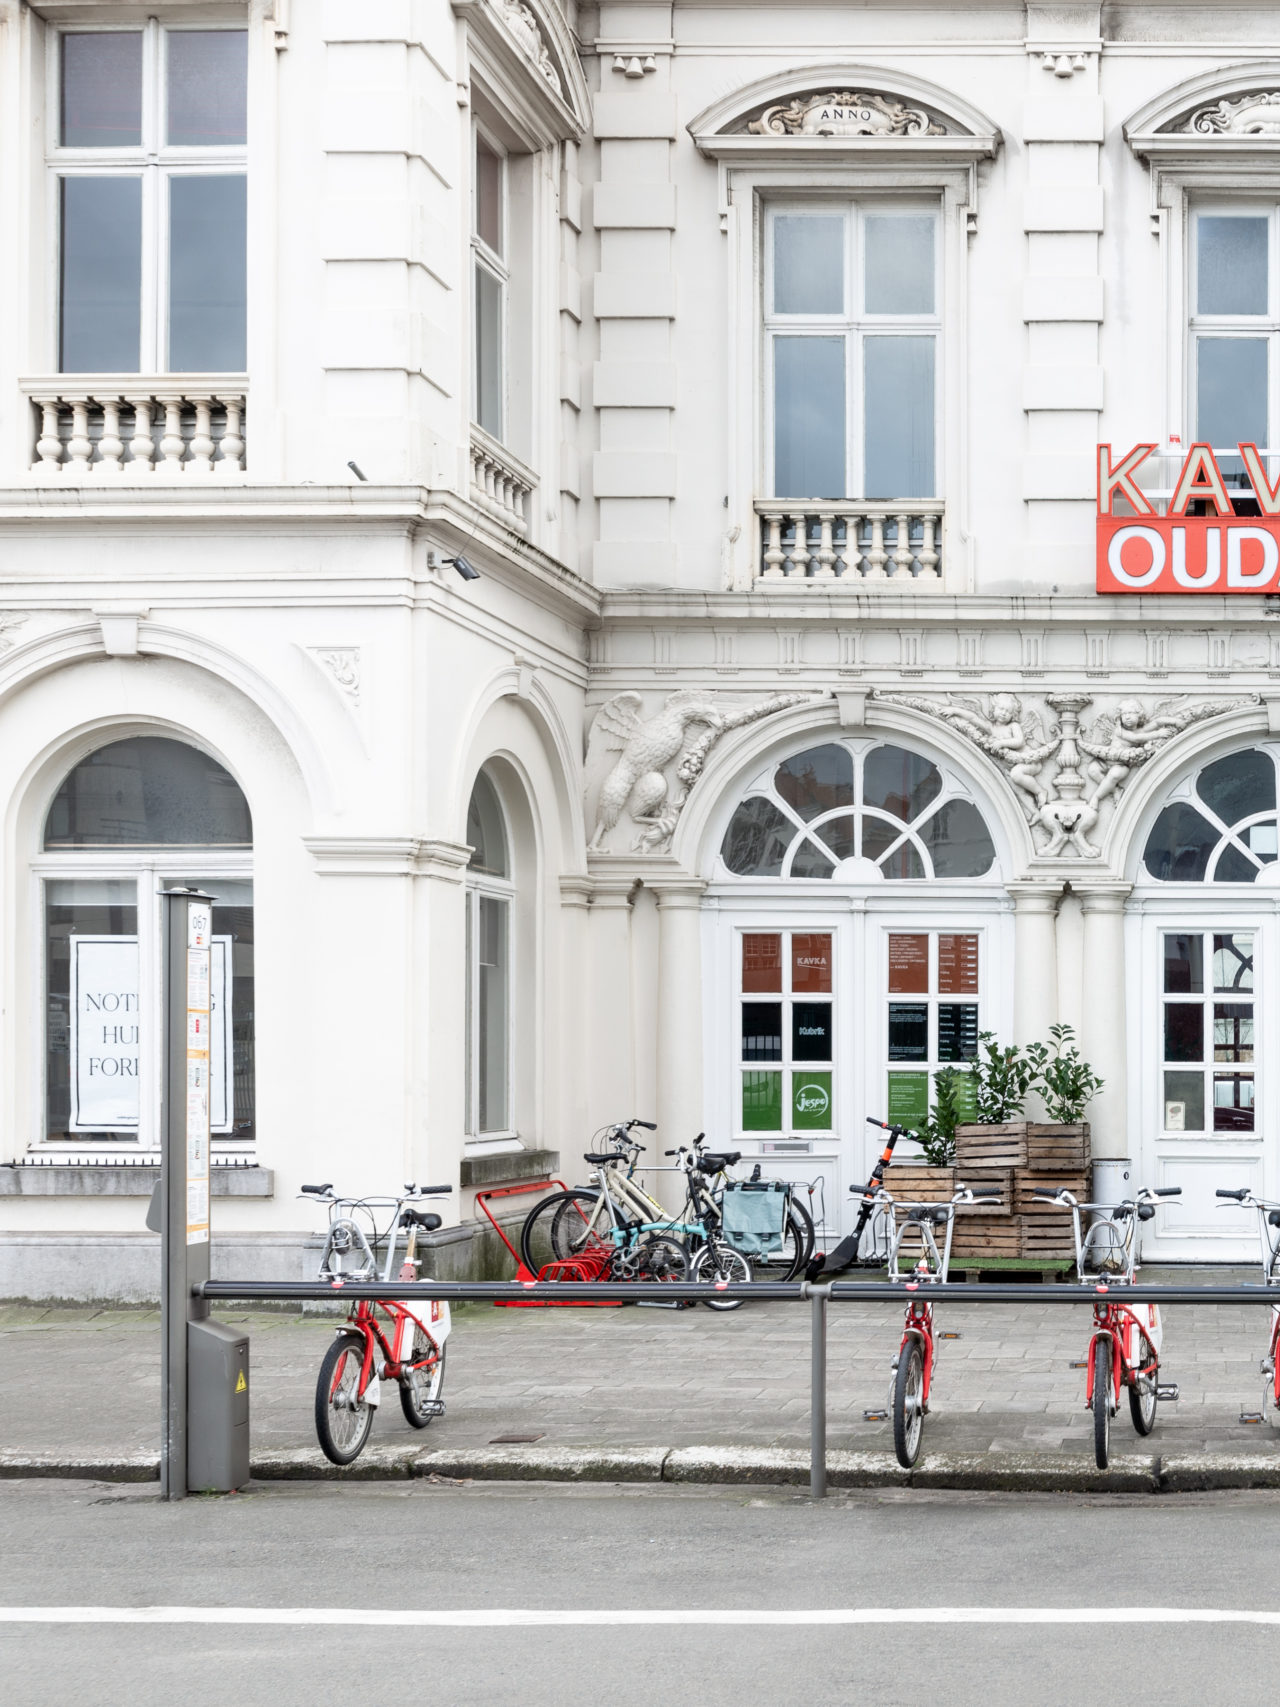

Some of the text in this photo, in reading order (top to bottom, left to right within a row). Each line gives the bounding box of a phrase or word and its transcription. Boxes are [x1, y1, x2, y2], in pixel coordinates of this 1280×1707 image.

[820, 109, 871, 121] ANNO
[192, 915, 207, 931] 067
[797, 957, 826, 965] KAVKA
[799, 1026, 825, 1036] Kubrik
